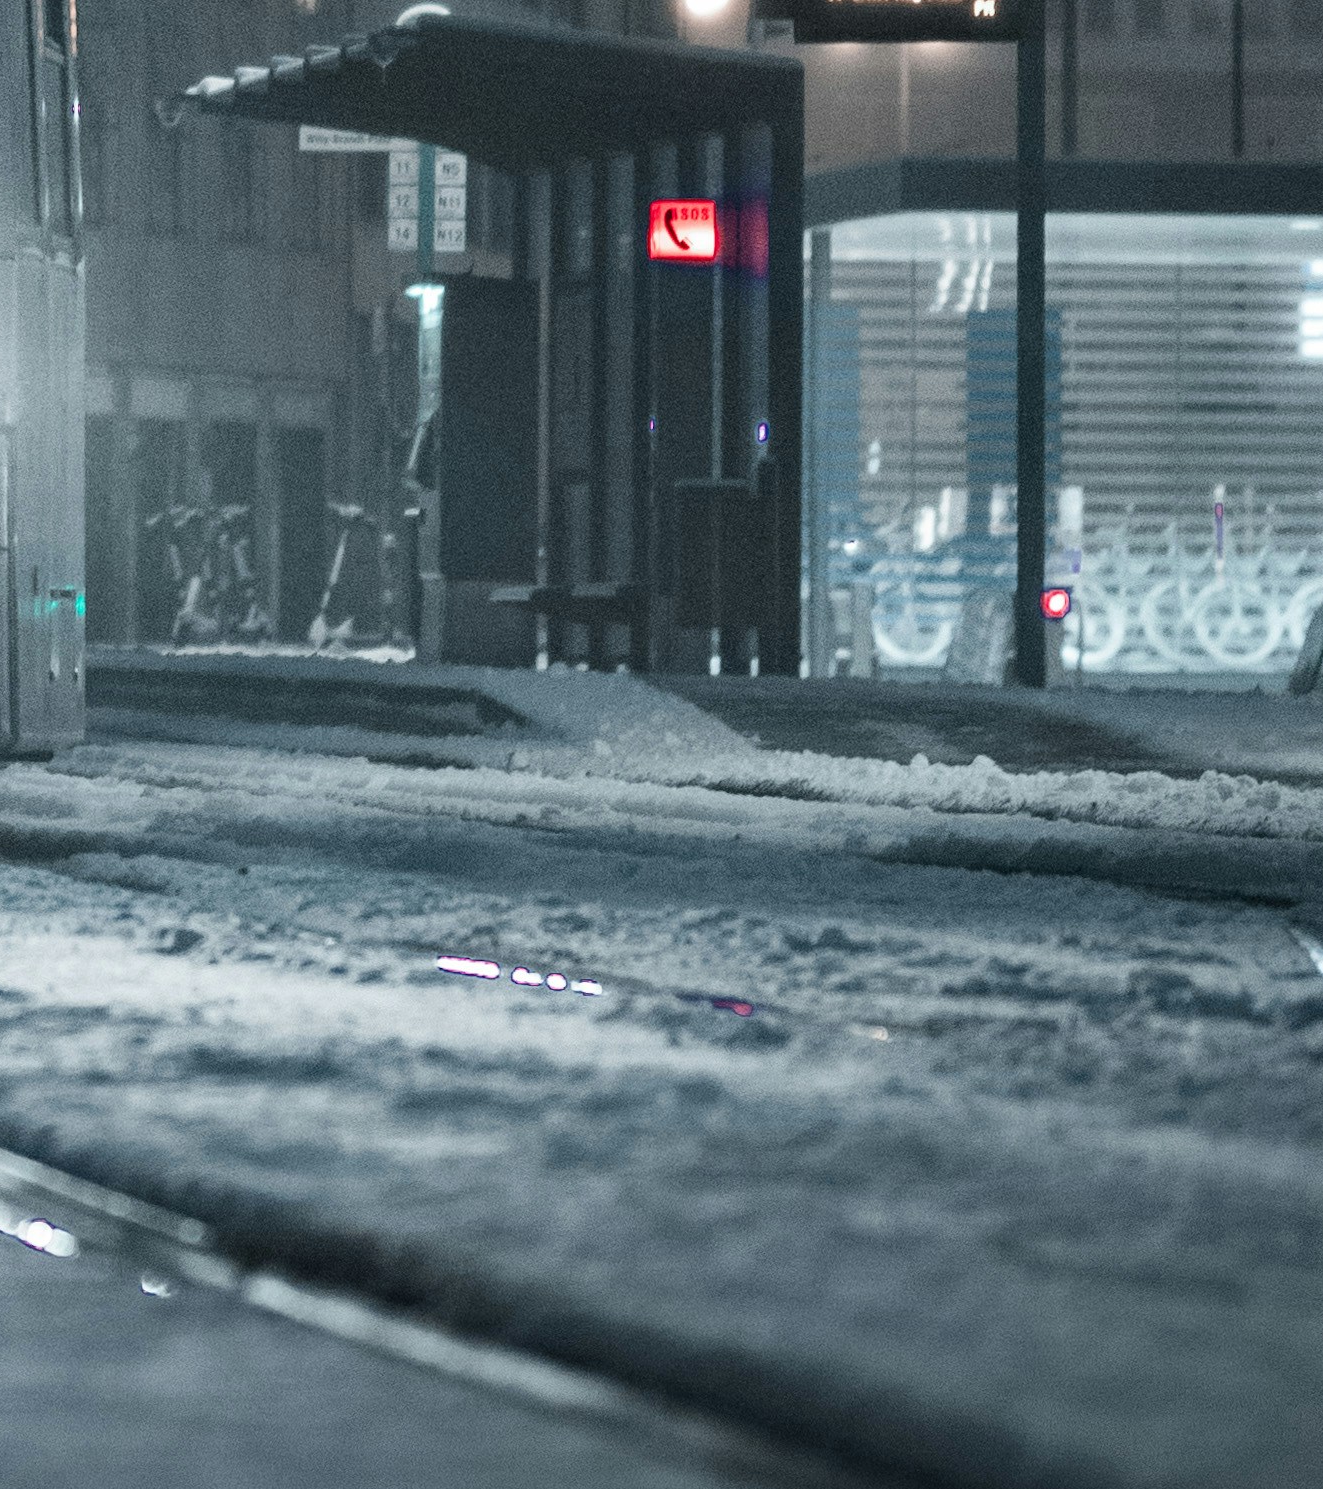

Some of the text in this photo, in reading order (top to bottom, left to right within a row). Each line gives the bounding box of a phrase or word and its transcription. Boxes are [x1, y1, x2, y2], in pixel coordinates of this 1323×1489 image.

[396, 161, 410, 173] 11
[396, 195, 410, 207] 12
[395, 228, 410, 241] 14
